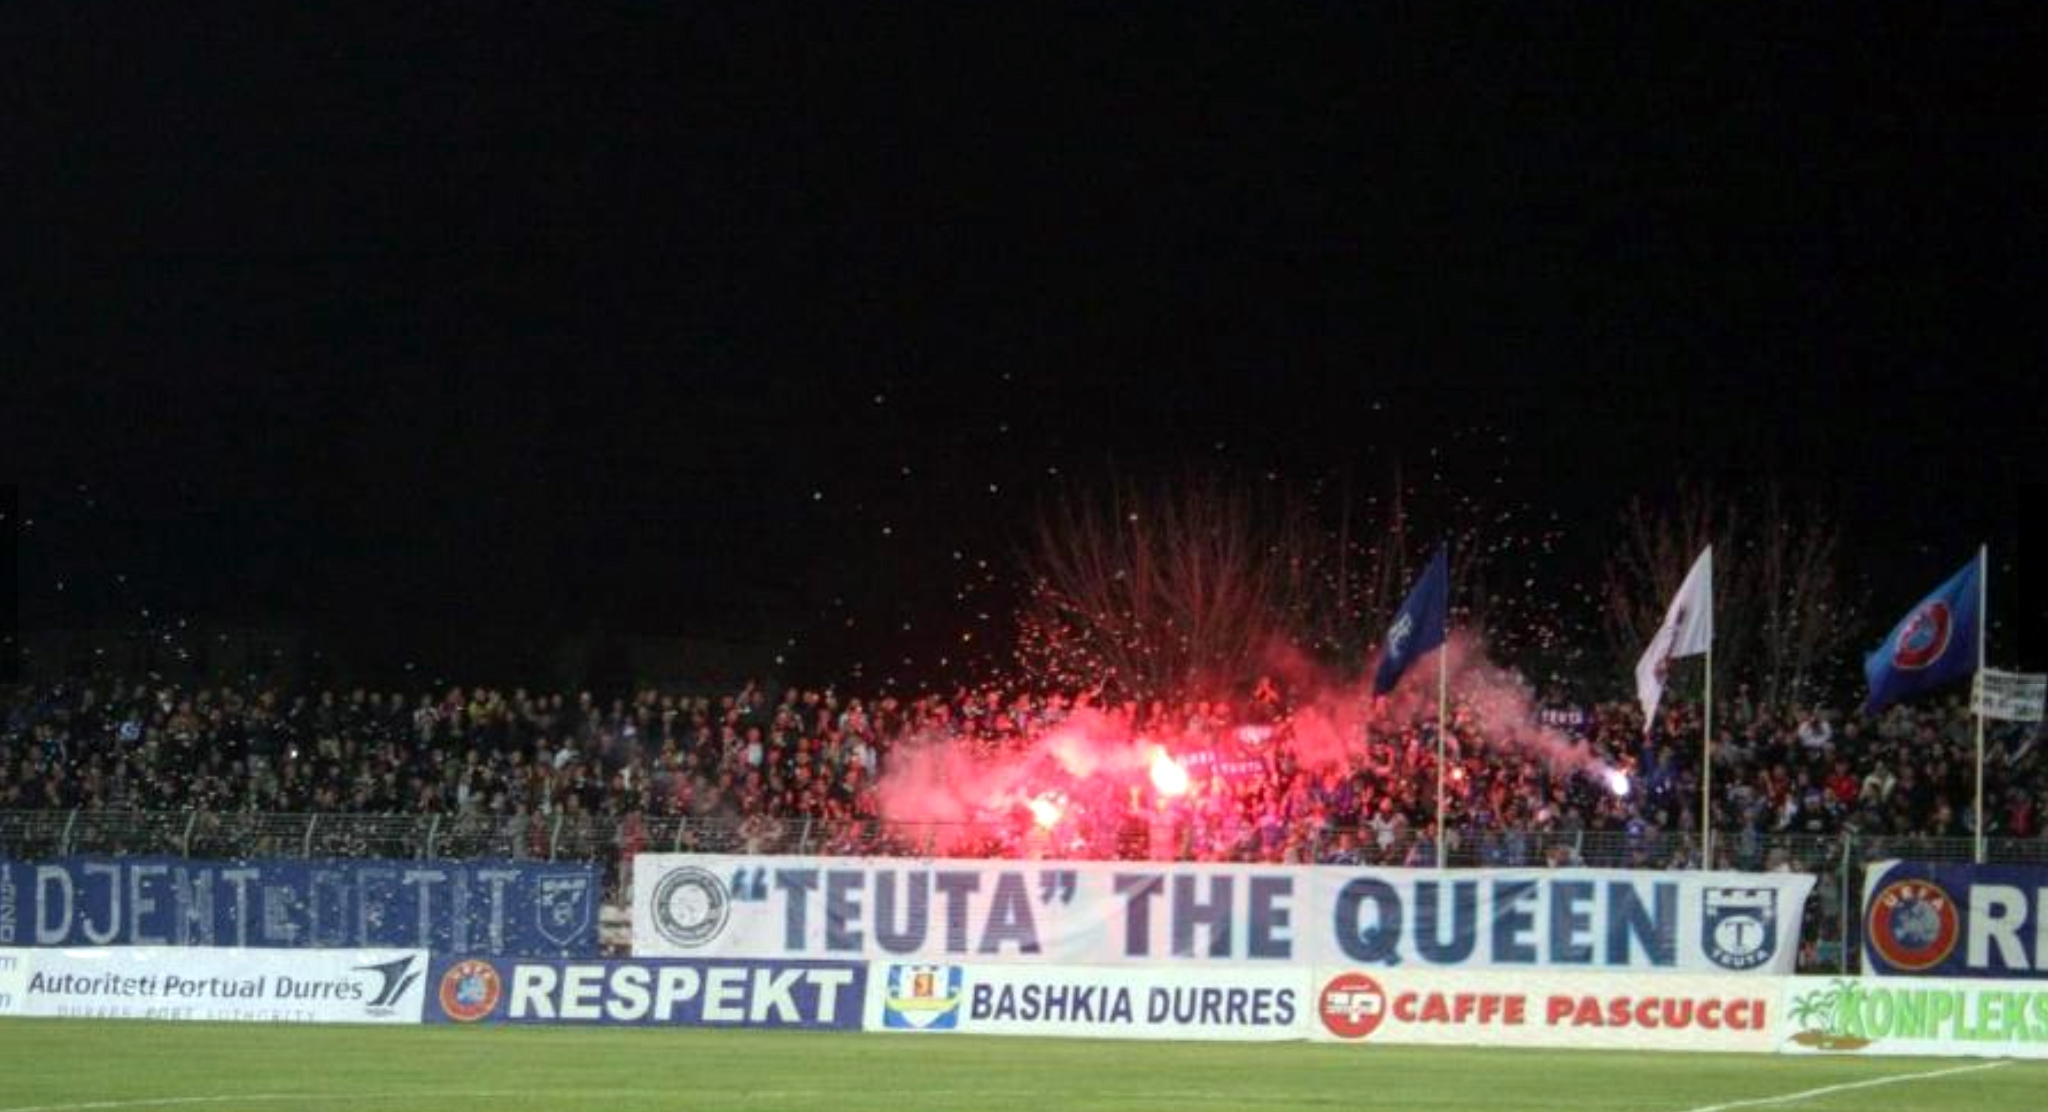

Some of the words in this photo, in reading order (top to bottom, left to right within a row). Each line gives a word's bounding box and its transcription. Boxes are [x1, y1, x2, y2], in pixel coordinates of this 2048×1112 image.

[1114, 874, 1295, 959] THE
[1333, 876, 1680, 967] QUEEN
[28, 970, 155, 997] Autoriteti
[162, 974, 266, 998] Portual
[508, 964, 853, 1022] RESPEKT
[970, 983, 1134, 1024] BASHKIA
[1147, 987, 1296, 1027] DURRES
[1392, 993, 1526, 1026] CAFFE
[1546, 996, 1766, 1031] PASCUCCI
